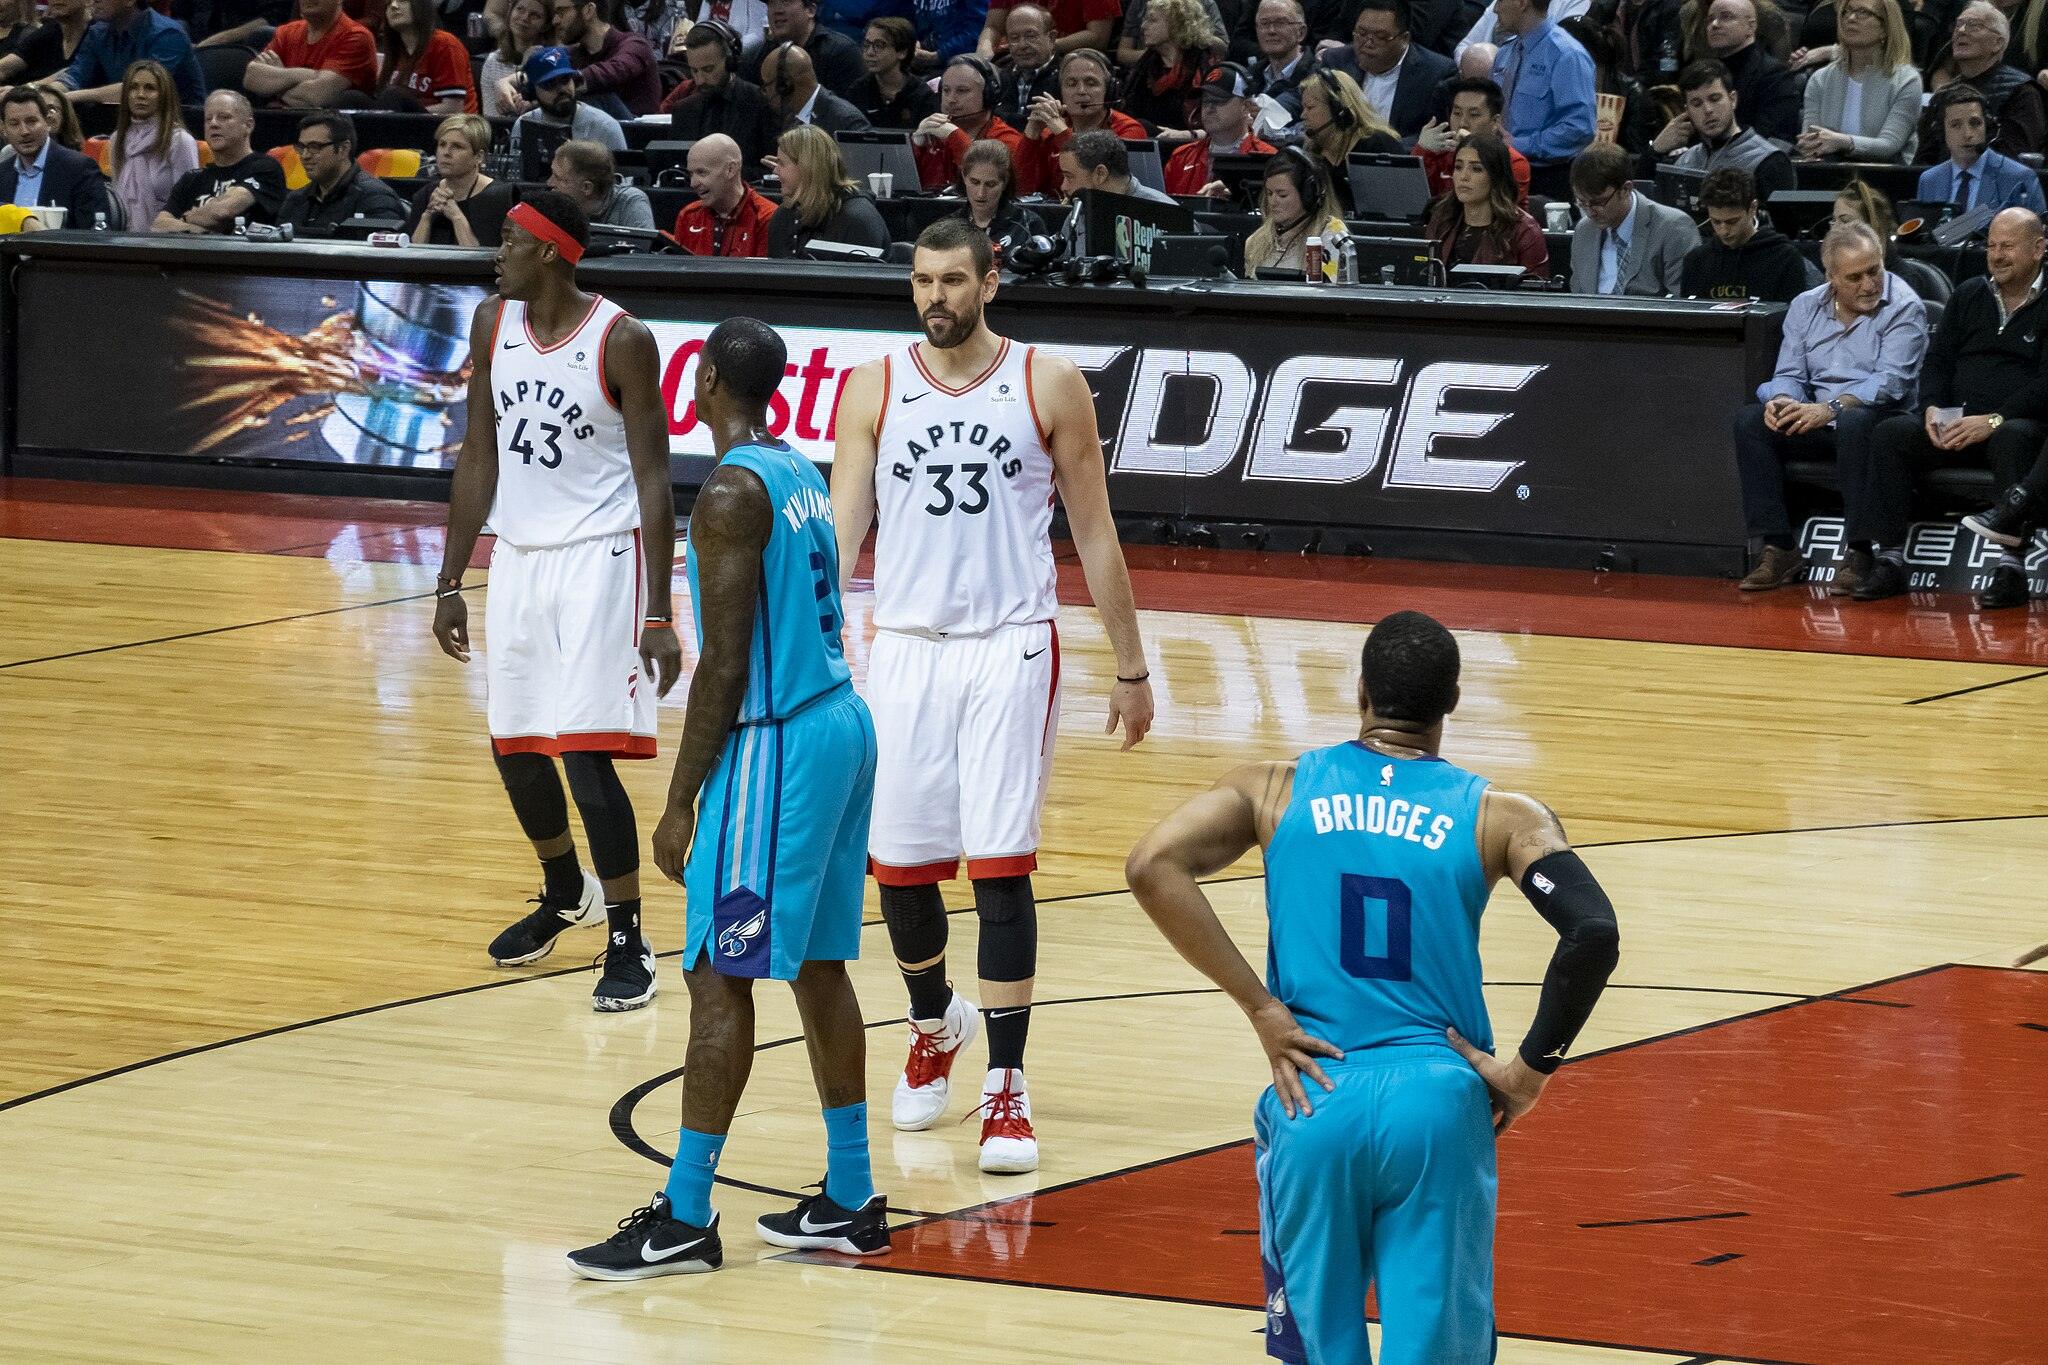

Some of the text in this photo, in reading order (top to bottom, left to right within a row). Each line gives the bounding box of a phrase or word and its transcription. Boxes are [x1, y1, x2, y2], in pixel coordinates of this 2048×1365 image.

[508, 418, 563, 469] 43
[1032, 343, 1549, 492] DGE
[892, 421, 1023, 483] RAPTORS
[924, 462, 990, 517] 33
[1310, 793, 1454, 850] BRIDGES
[1340, 873, 1412, 982] 0
